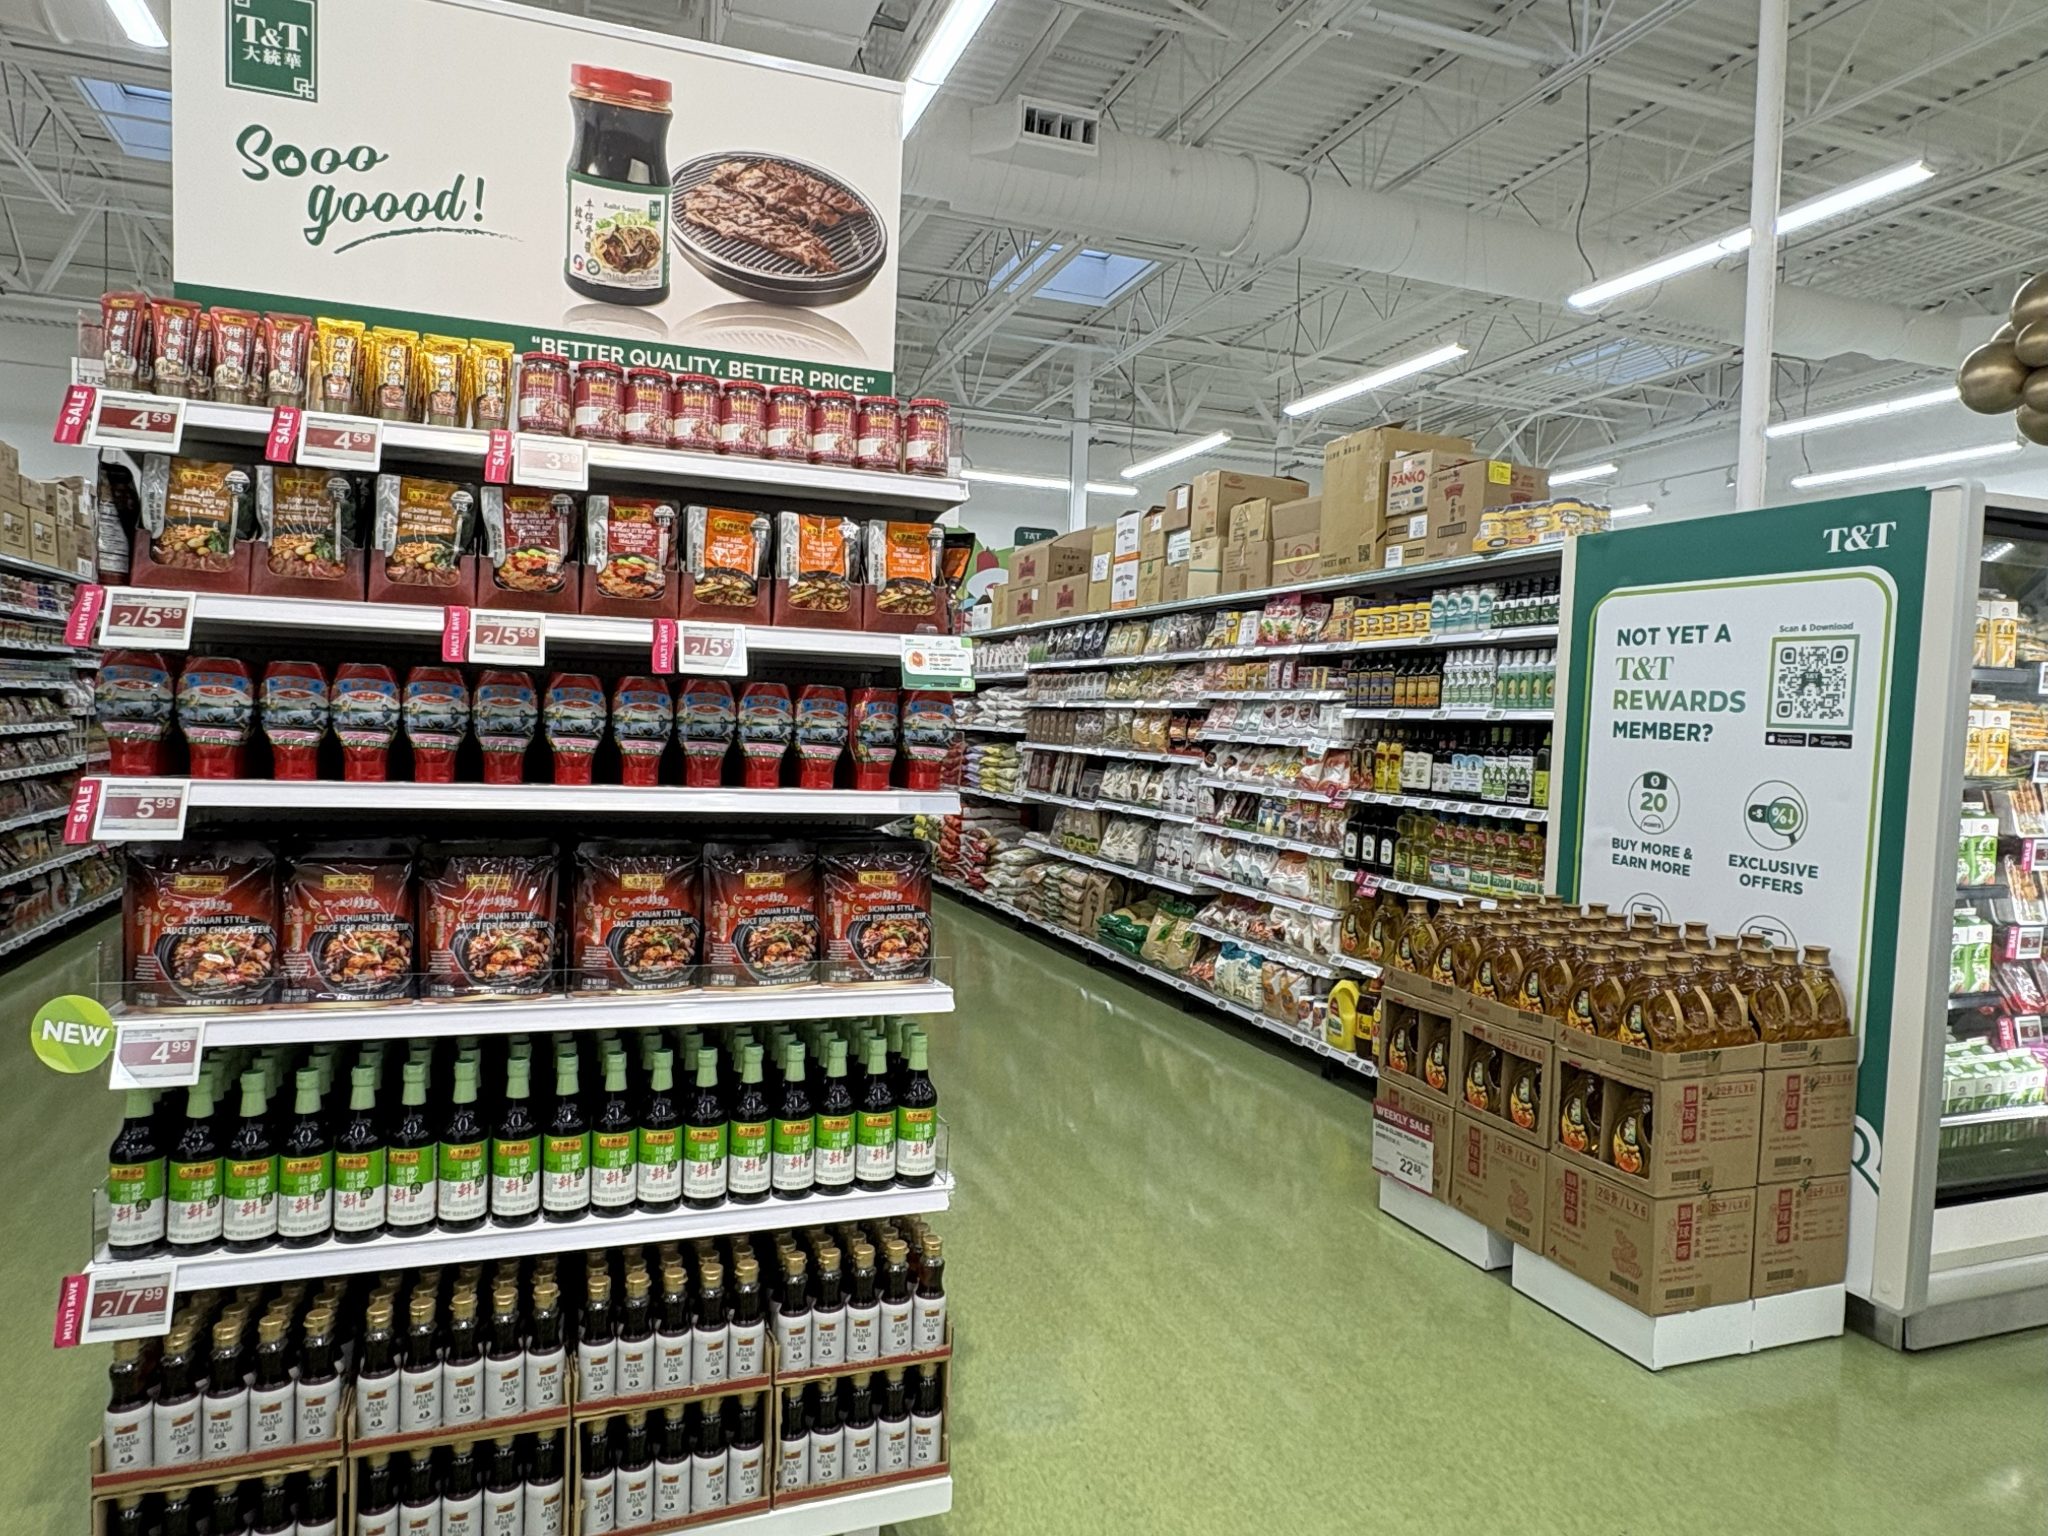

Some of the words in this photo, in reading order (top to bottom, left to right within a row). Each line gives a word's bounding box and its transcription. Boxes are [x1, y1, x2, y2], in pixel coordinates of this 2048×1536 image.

[235, 13, 308, 52] T&T
[242, 46, 302, 69] 大統華
[235, 124, 389, 181] Sooo
[303, 174, 484, 246] goood!
[629, 349, 724, 377] QUALITY.
[729, 361, 805, 384] BETTER
[66, 390, 88, 425] SALE
[276, 411, 294, 444] SALE
[492, 434, 507, 466] SALE
[1823, 521, 1897, 554] T&T
[81, 591, 95, 613] SAVE
[76, 615, 88, 641] MULTI
[452, 612, 461, 631] SAVE
[1780, 624, 1799, 633] Scan
[1802, 624, 1807, 632] &
[1810, 622, 1854, 632] Download
[450, 632, 461, 657] MULTI
[1617, 627, 1660, 647] NOT
[1667, 624, 1709, 645] YET
[1714, 624, 1732, 643] A
[660, 645, 669, 669] MULTI
[1616, 656, 1674, 681] T&T
[1613, 689, 1746, 713] REWARDS
[1613, 721, 1714, 743] MEMBER?
[74, 785, 93, 823] SALE
[1640, 792, 1668, 813] 20
[1612, 838, 1638, 852] BUY
[1641, 842, 1680, 859] MORE
[1684, 848, 1693, 860] &
[1612, 853, 1648, 870] EARN
[1650, 860, 1691, 877] MORE
[1728, 854, 1819, 879] EXCLUSIVE
[1739, 874, 1804, 896] OFFERS
[184, 916, 222, 924] SICHUAN
[371, 914, 394, 922] STYLE
[510, 911, 534, 920] STYLE
[314, 925, 338, 933] SAUCE
[42, 1020, 110, 1047] NEW
[1376, 1104, 1409, 1125] WEEKLY
[1409, 1118, 1431, 1136] SALE
[68, 1282, 79, 1307] SAVE
[63, 1310, 76, 1340] MULTI
